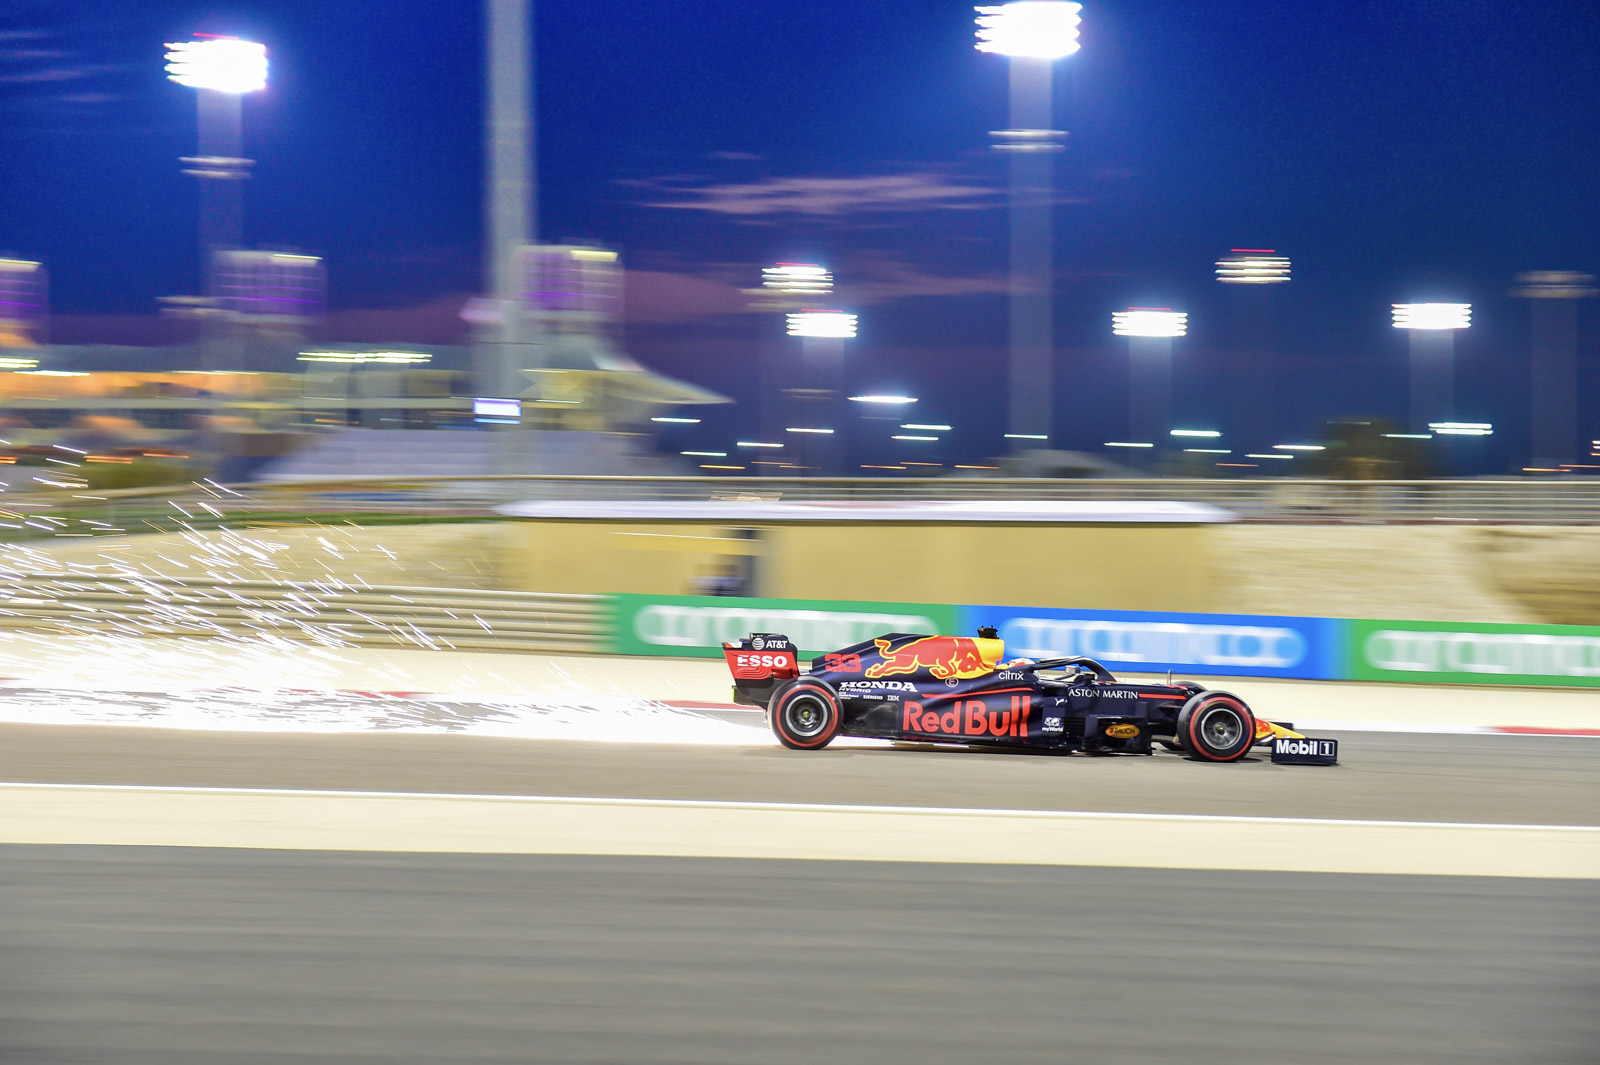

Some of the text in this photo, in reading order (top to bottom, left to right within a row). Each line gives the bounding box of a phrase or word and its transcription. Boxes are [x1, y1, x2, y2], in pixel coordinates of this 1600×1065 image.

[766, 640, 788, 649] AT&T
[737, 655, 787, 667] ESSO
[825, 653, 861, 672] 33
[998, 670, 1024, 680] citrix
[840, 681, 918, 692] HONDA
[1068, 688, 1138, 699] ASTON MARTIN
[1276, 740, 1317, 755] Mobil
